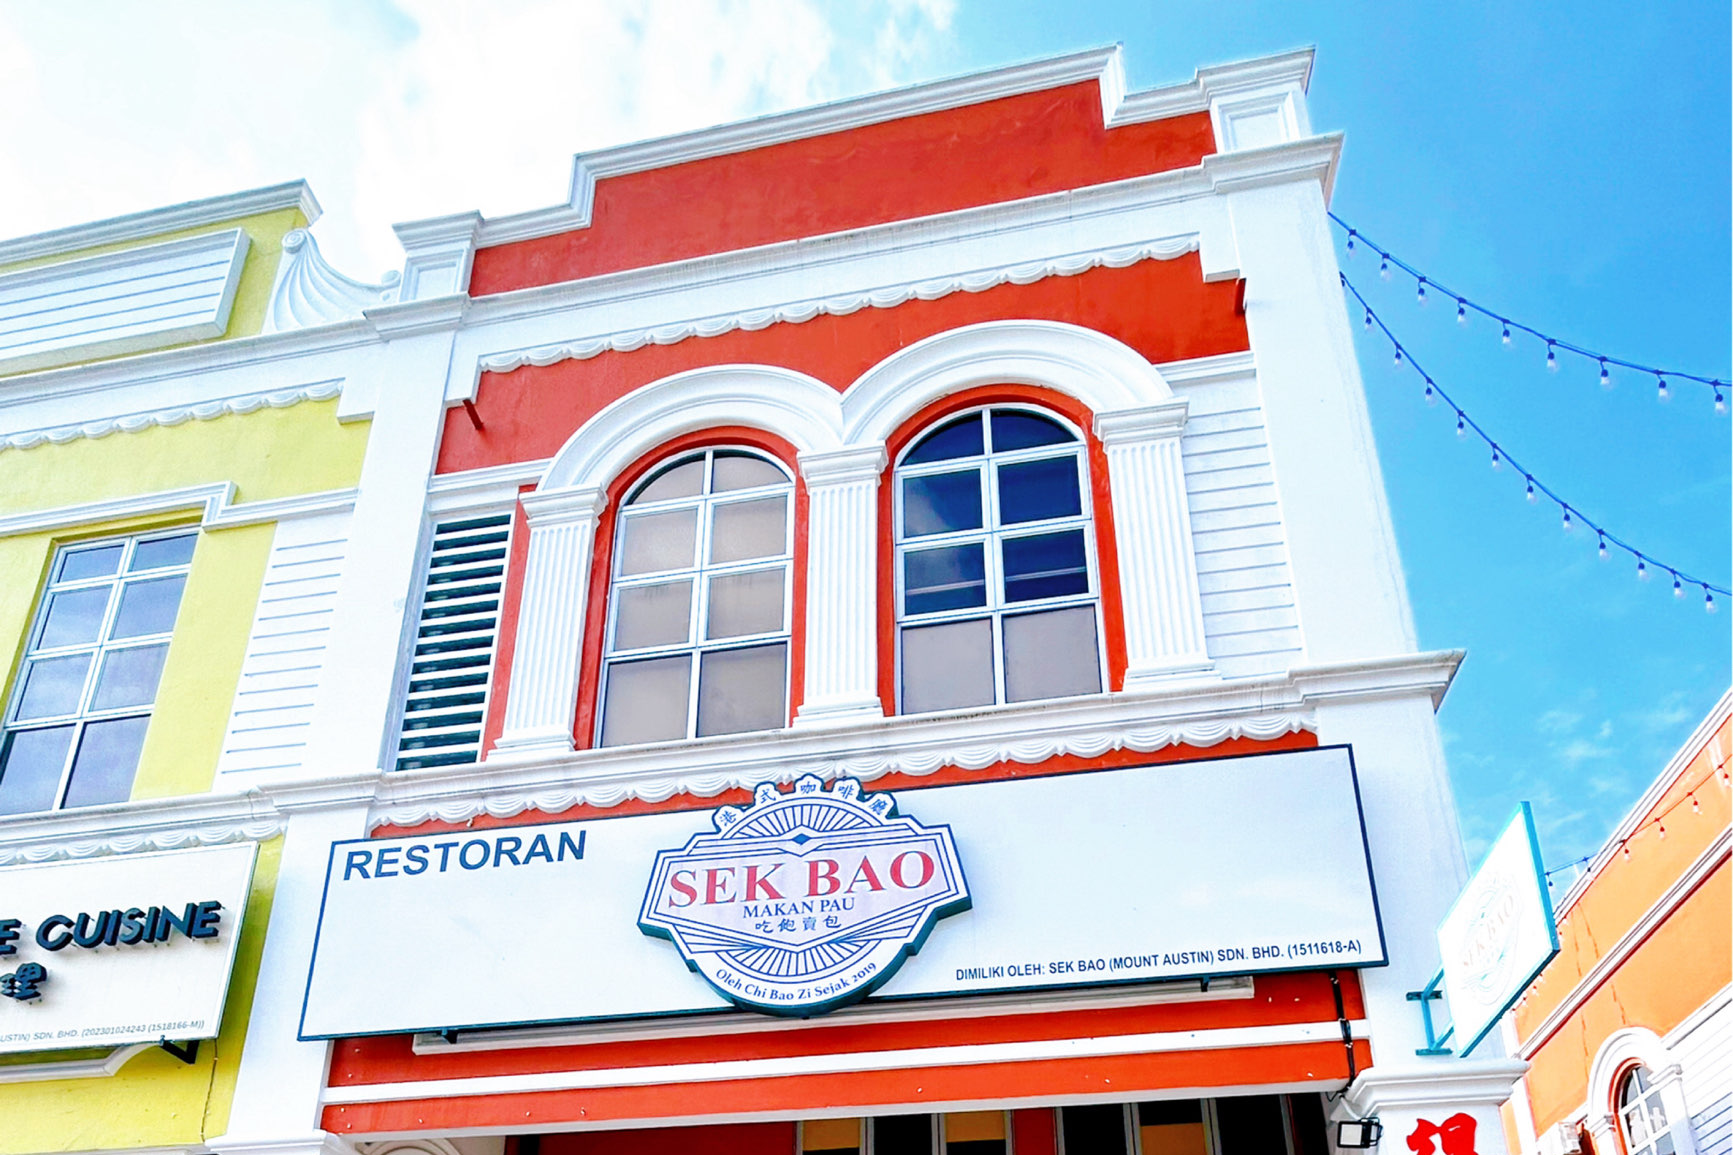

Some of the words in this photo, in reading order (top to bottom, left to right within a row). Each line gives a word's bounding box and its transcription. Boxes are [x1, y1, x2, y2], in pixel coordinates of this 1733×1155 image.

[343, 830, 587, 881] RESTORAN
[668, 863, 786, 908] SEK
[805, 850, 935, 898] BAO
[35, 900, 222, 951] CUISINE
[743, 901, 815, 919] MAKAN
[820, 896, 855, 913] PAU
[755, 915, 842, 934] 吃飽賣包
[956, 965, 1005, 981] DIMILIKI
[1007, 963, 1046, 978] OLEH:
[1048, 961, 1075, 975] SEK
[1078, 958, 1106, 973] BAO
[1109, 953, 1159, 973] (MOUNT
[1163, 950, 1214, 967] AUSTIN)
[1217, 947, 1250, 961] SDN.
[1252, 944, 1285, 959] BHD.
[1287, 939, 1362, 959] (1511618-A)
[716, 968, 742, 990] Oleh
[744, 983, 767, 999] Chi
[769, 989, 795, 1001] Bao
[797, 987, 812, 1000] Zi
[815, 977, 851, 997] Sejak
[852, 962, 878, 983] 2019
[33, 1031, 54, 1040] SDN.
[57, 1029, 80, 1039] BHD.
